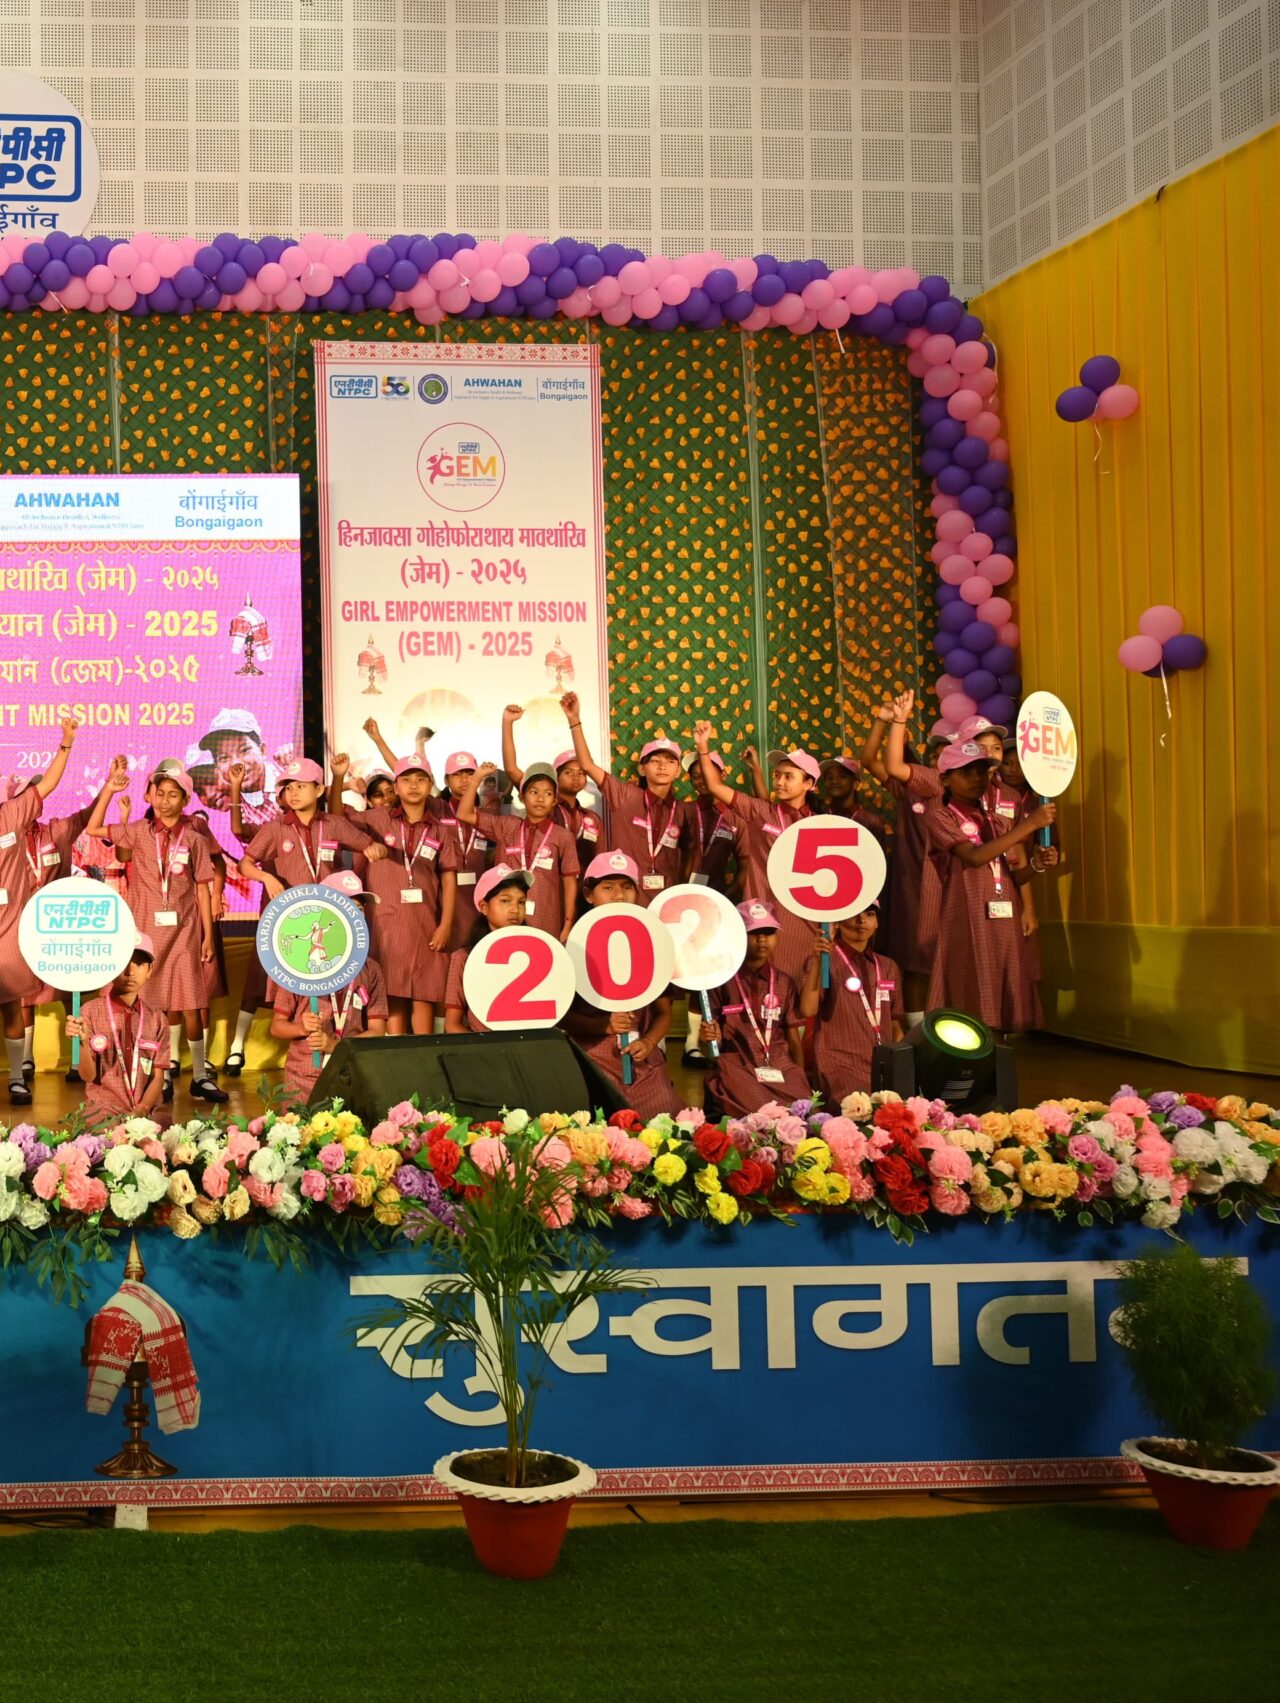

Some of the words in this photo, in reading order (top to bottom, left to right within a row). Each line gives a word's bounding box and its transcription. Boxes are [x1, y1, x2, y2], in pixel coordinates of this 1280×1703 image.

[337, 388, 371, 396] NTPC
[463, 378, 522, 388] AHWAHAN
[539, 392, 588, 401] Bongaigaon
[437, 455, 497, 477] GEM
[14, 492, 120, 508] AHWAHAN
[179, 489, 259, 513] बोंगाईगाँव
[175, 515, 263, 531] Bongaigaon
[337, 520, 412, 547] हिनजावसा
[76, 560, 136, 596] (जेम)
[162, 565, 219, 591] २०२५
[400, 555, 450, 588] (जेम)
[470, 558, 527, 585] २०२५
[341, 600, 380, 622] GIRL
[385, 601, 513, 622] EMPOWERMENT
[518, 601, 587, 622] MISSION
[52, 605, 118, 642] (जेम)
[144, 610, 219, 637] 2025
[398, 631, 461, 663] (GEM)
[481, 631, 533, 656] 2025
[28, 704, 131, 726] MISSION
[138, 703, 195, 725] 2025
[1028, 721, 1075, 759] GEM
[788, 827, 864, 911] 5
[43, 900, 111, 917] एनटीपीसी
[260, 906, 279, 952] BARDWI
[279, 887, 319, 906] SHIKLA
[324, 889, 359, 919] LADIES
[353, 919, 366, 949] CLUB
[48, 916, 107, 929] NTPC
[41, 938, 112, 958] बोंगाईगाँव
[585, 915, 655, 1001] 0
[37, 961, 116, 974] Bongaigaon
[270, 965, 297, 988] NTPC
[299, 959, 360, 992] BONGAIGAON
[485, 935, 557, 1022] 2
[348, 1257, 1250, 1427] सुस्वागत
